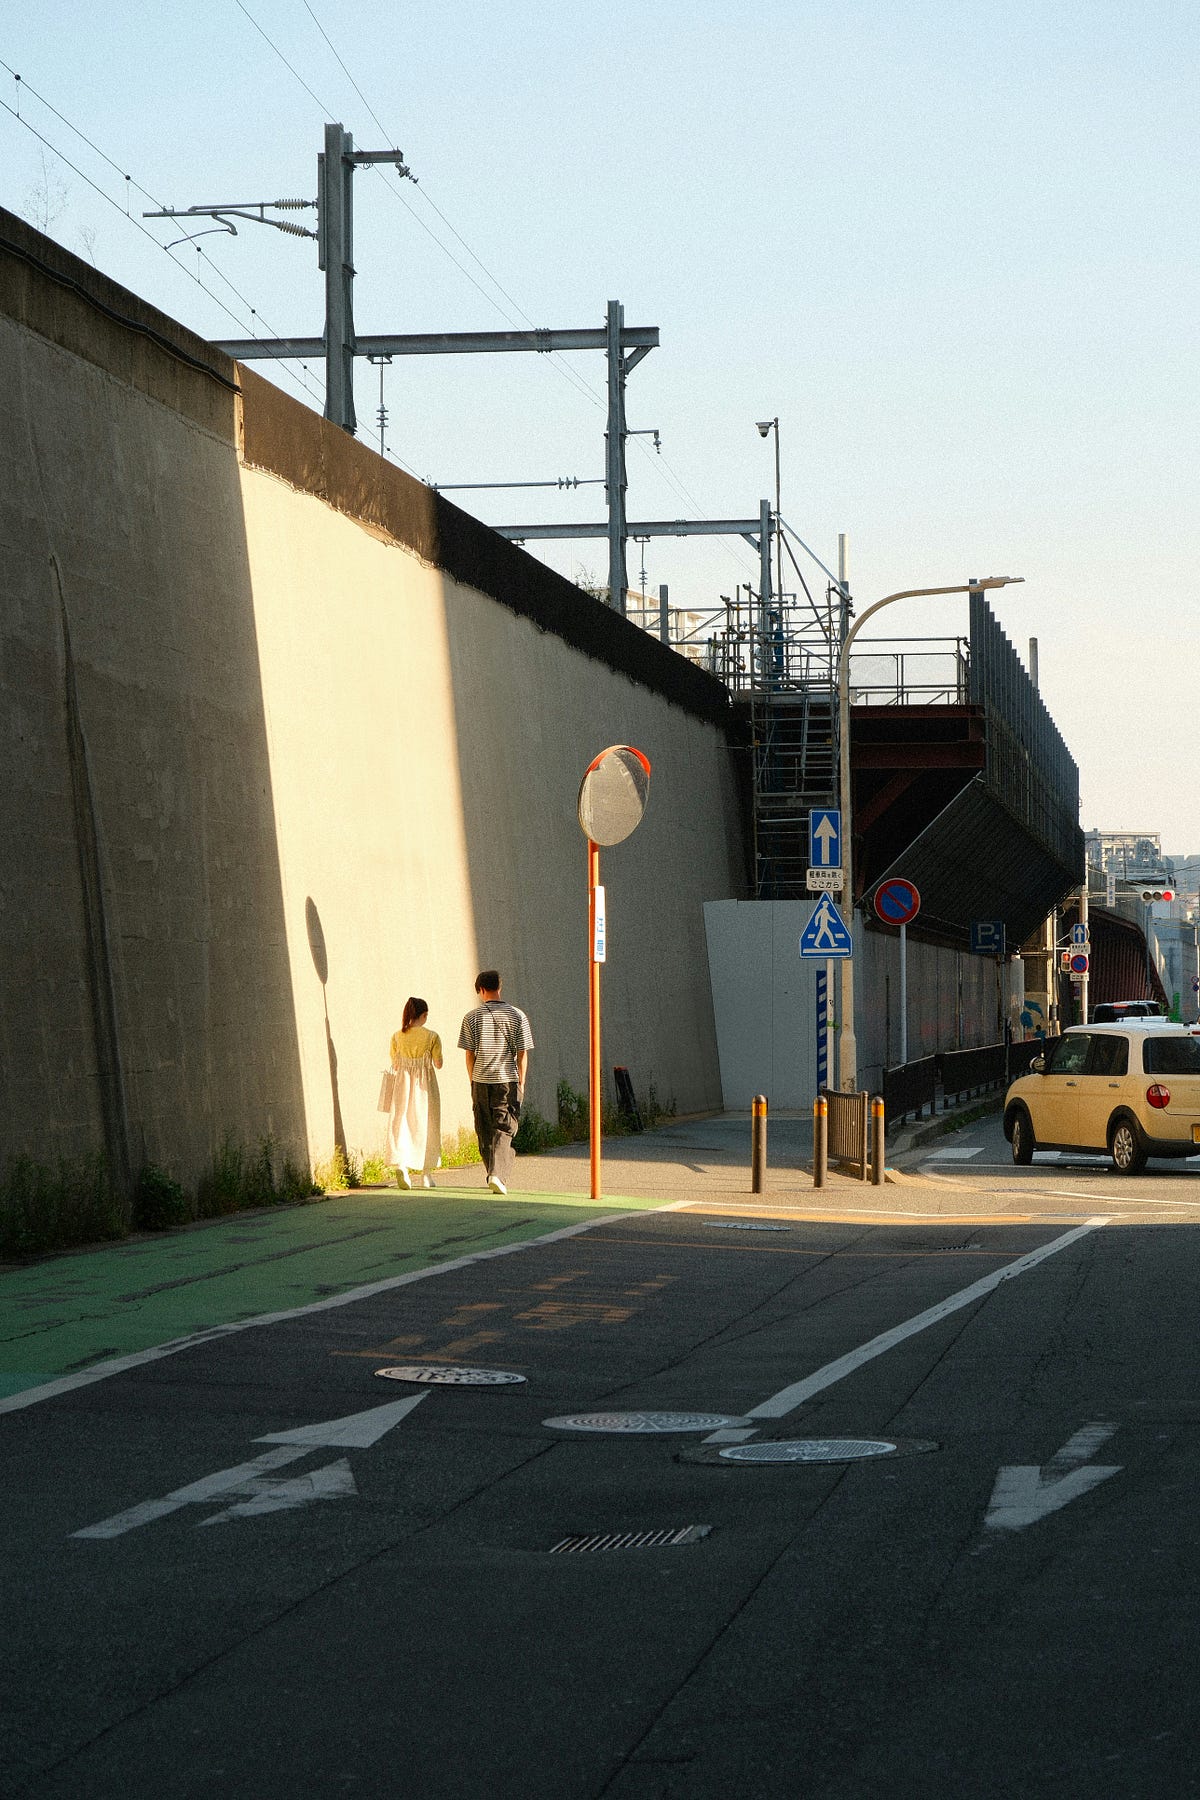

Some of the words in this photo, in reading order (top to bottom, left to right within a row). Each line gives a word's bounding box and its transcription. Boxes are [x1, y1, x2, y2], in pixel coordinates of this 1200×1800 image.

[811, 880, 840, 888] ここから
[977, 923, 995, 944] P
